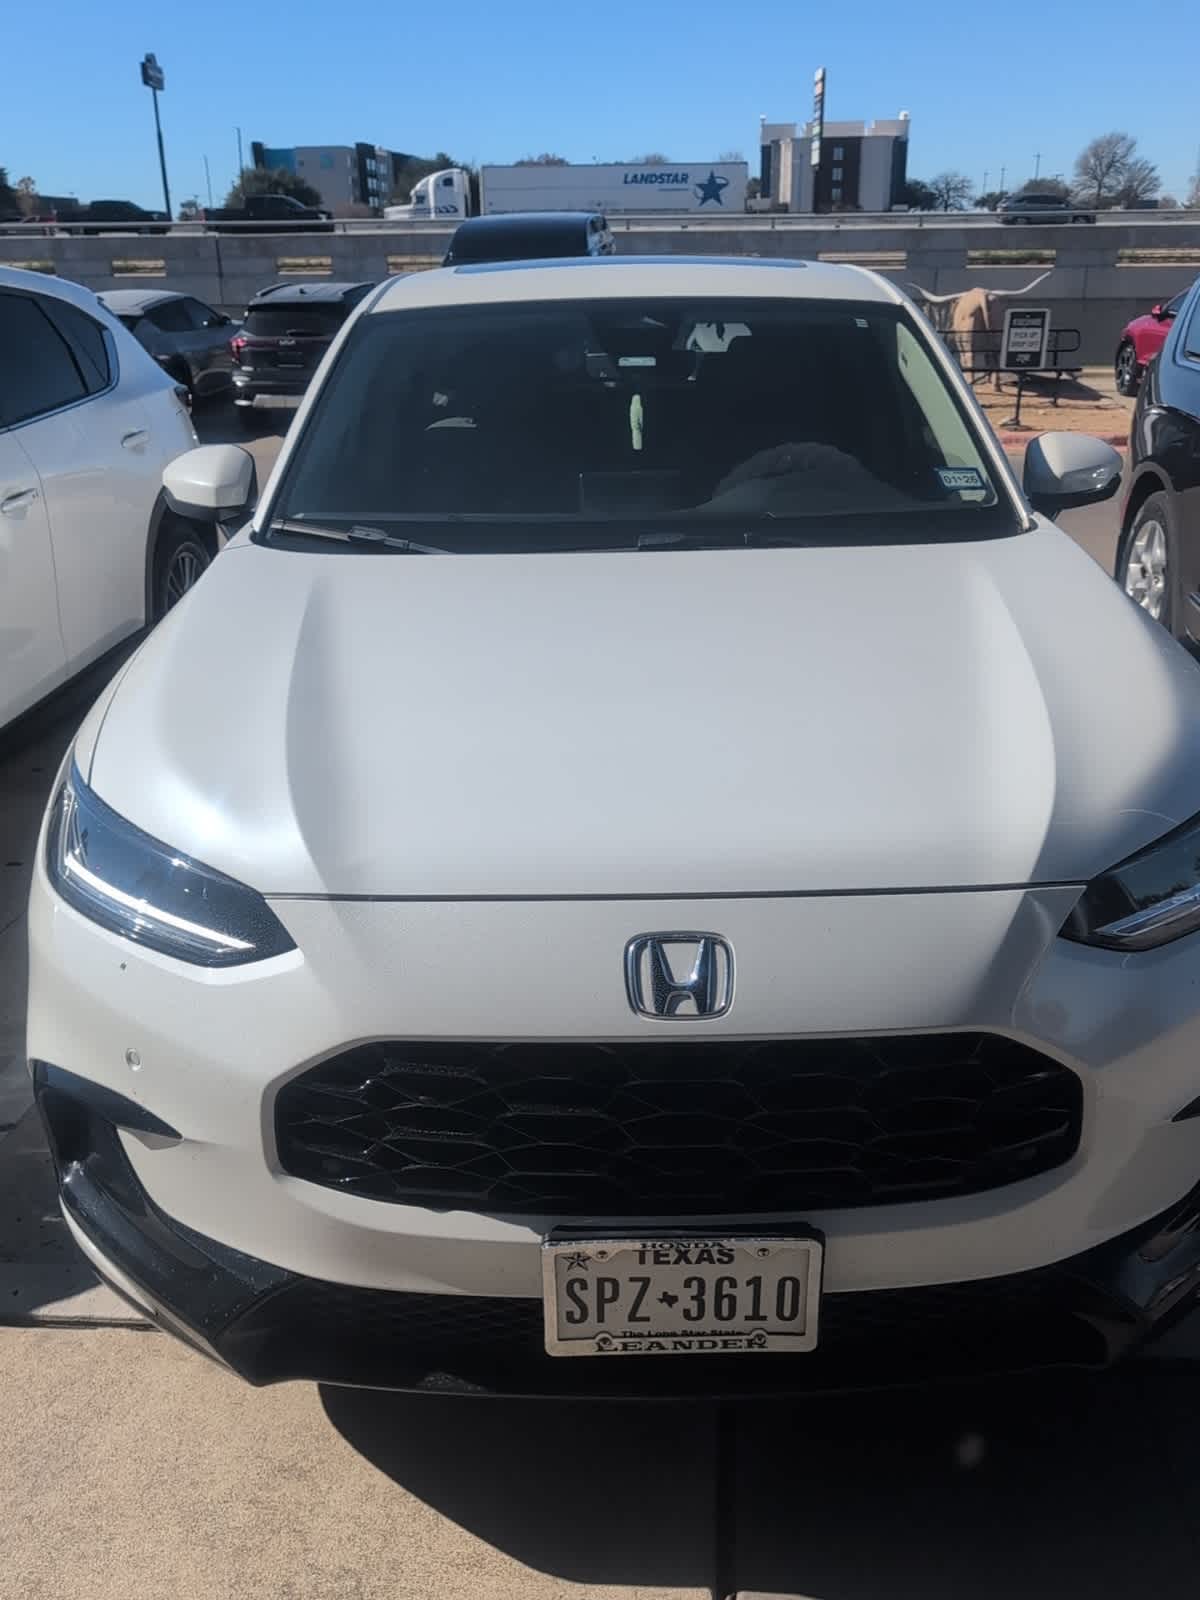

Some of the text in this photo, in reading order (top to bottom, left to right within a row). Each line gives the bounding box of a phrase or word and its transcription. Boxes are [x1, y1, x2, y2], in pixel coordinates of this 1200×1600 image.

[623, 173, 689, 185] LANDSTAR
[640, 1241, 726, 1249] HONDA
[632, 1248, 736, 1265] TEXAS
[565, 1275, 800, 1324] SPZ 3610
